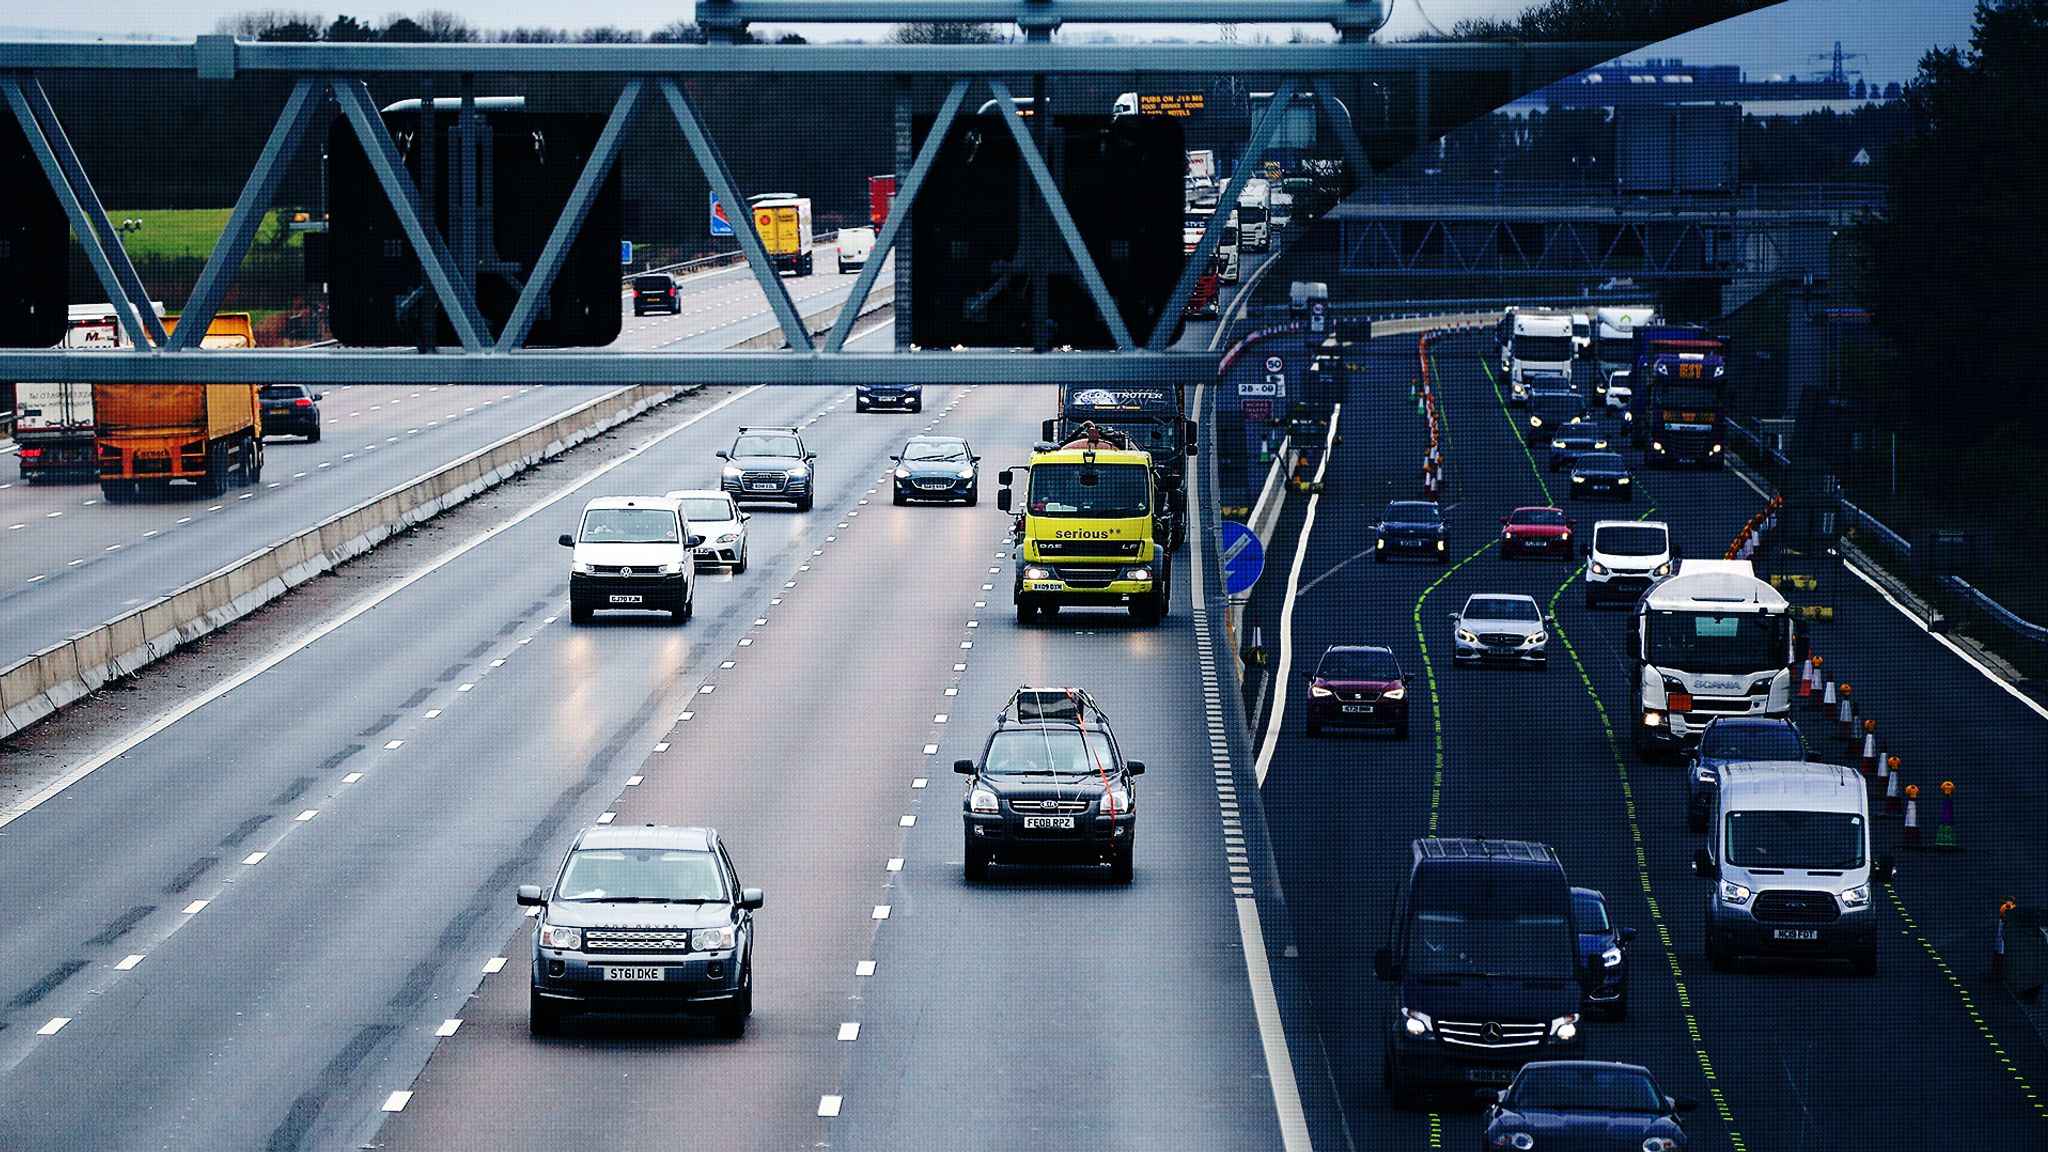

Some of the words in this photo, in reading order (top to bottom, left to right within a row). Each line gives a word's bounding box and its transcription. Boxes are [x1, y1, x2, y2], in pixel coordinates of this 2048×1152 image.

[1267, 360, 1281, 368] 50
[1693, 680, 1741, 689] SCANIA
[1052, 818, 1070, 828] RPZ
[610, 968, 635, 979] ST61
[637, 968, 659, 979] DKE
